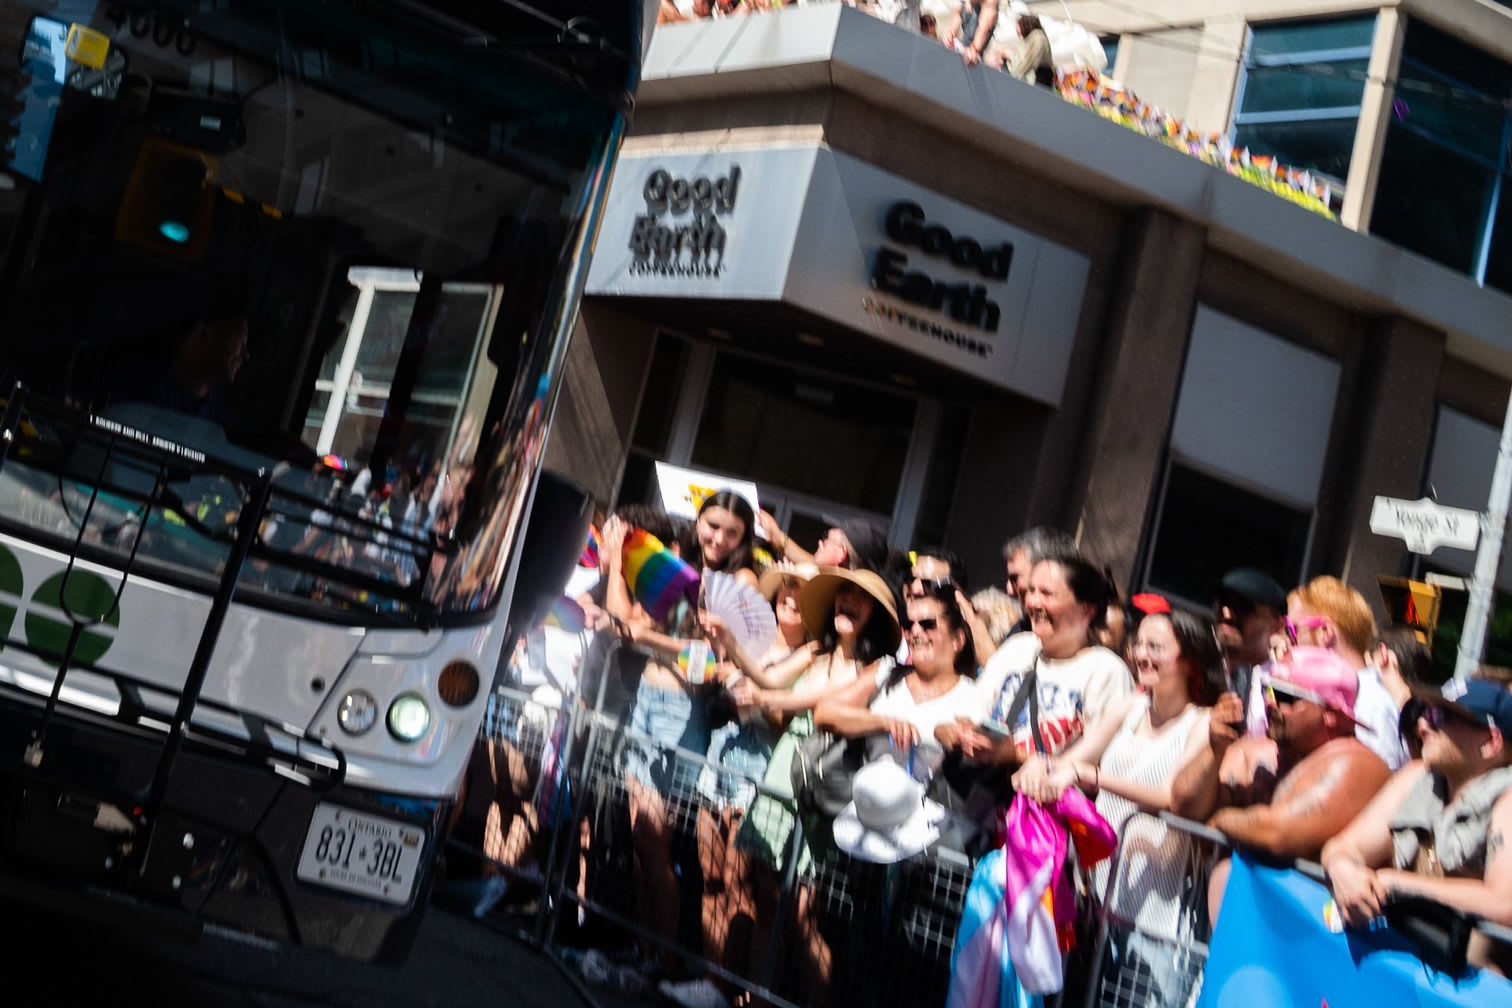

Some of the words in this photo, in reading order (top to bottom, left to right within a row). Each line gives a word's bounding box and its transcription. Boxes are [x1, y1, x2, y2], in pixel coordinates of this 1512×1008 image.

[642, 164, 742, 211] Good
[884, 198, 1015, 281] Good
[871, 244, 1002, 333] Earth
[347, 817, 392, 839] ONTARIO
